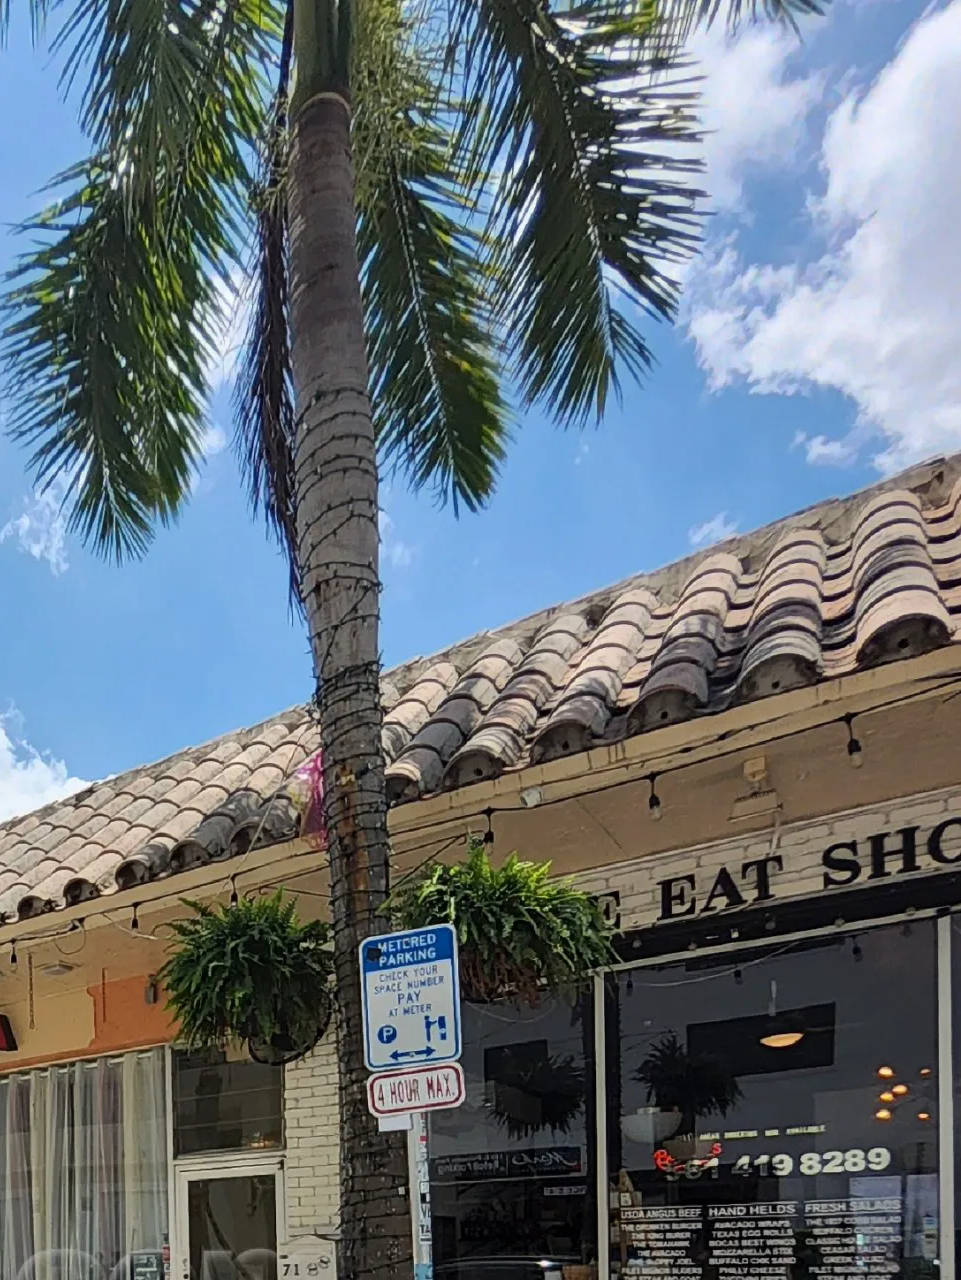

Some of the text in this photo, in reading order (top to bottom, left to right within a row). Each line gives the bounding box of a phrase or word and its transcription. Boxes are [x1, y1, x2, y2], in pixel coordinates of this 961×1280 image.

[656, 855, 784, 921] EAT
[379, 947, 436, 967] PARKING
[379, 965, 438, 983] CHECK YOUR
[374, 975, 445, 995] SPACE NUMBER
[397, 990, 421, 1005] PAY
[389, 1003, 432, 1018] AT METER
[378, 1073, 456, 1106] 4 HOUR MAX.
[731, 1154, 793, 1177] 419
[800, 1147, 891, 1175] 8289
[646, 1209, 676, 1218] ANGUS
[679, 1208, 702, 1217] BEEF
[709, 1205, 796, 1216] HAND HELDS
[805, 1200, 901, 1212] FRESH SALADS
[711, 1230, 739, 1238] TEXAS
[283, 1263, 299, 1276] 71
